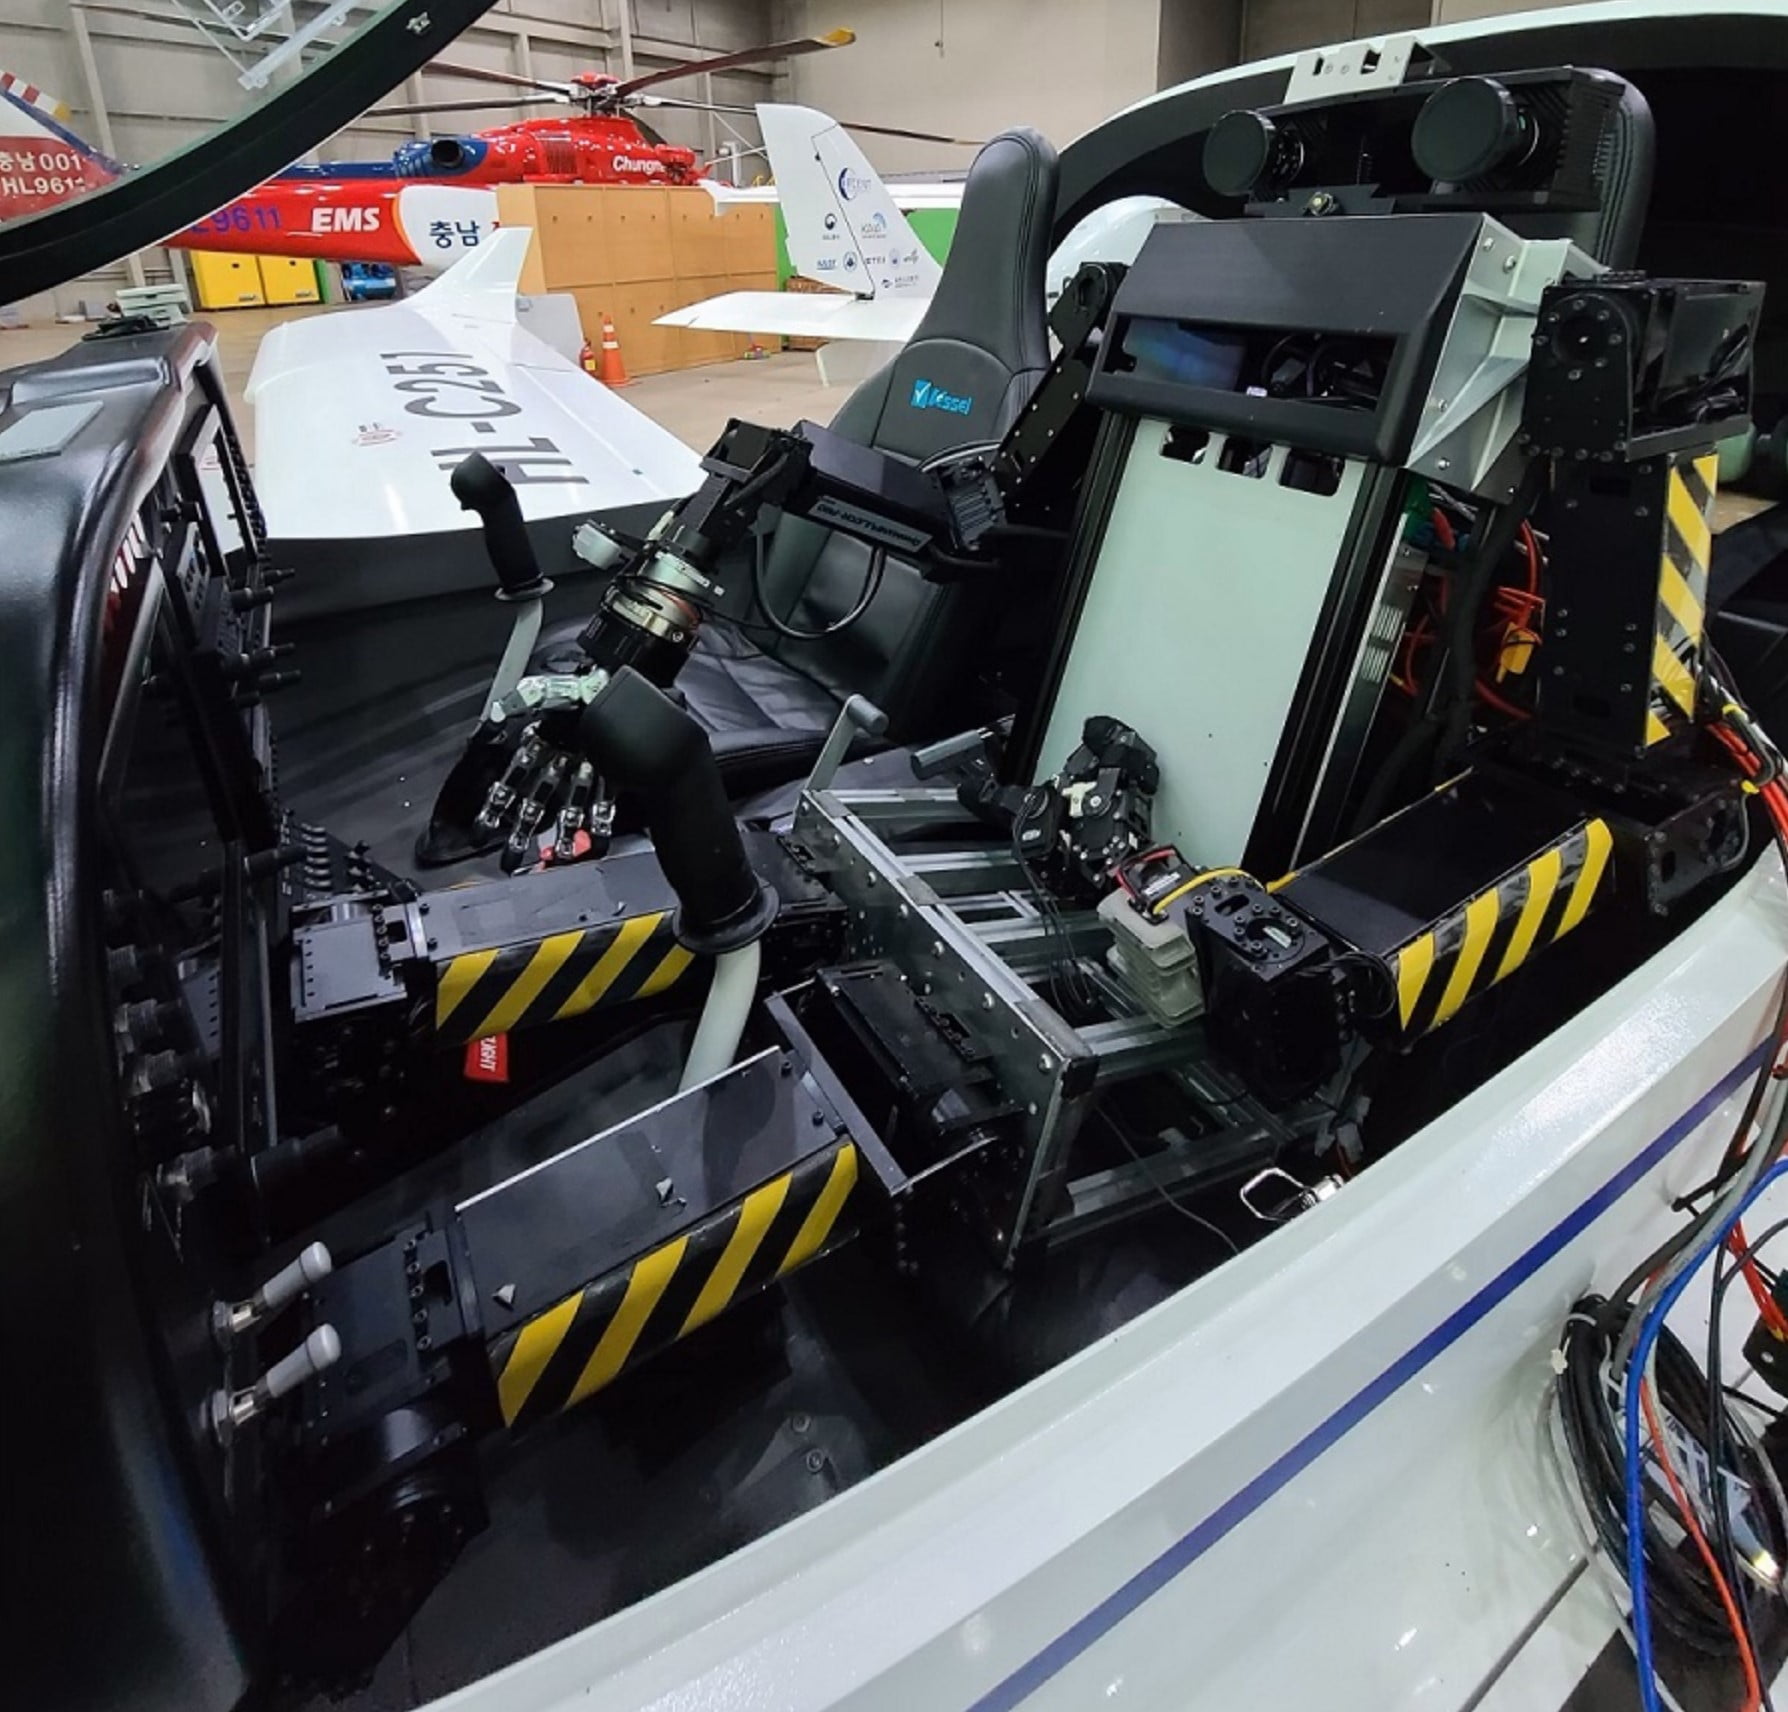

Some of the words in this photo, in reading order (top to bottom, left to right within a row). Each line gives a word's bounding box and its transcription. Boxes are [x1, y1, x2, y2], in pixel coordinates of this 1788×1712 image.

[39, 153, 82, 171] 001
[612, 155, 666, 175] Chungn
[312, 207, 380, 232] EMS
[429, 220, 480, 249] 충남
